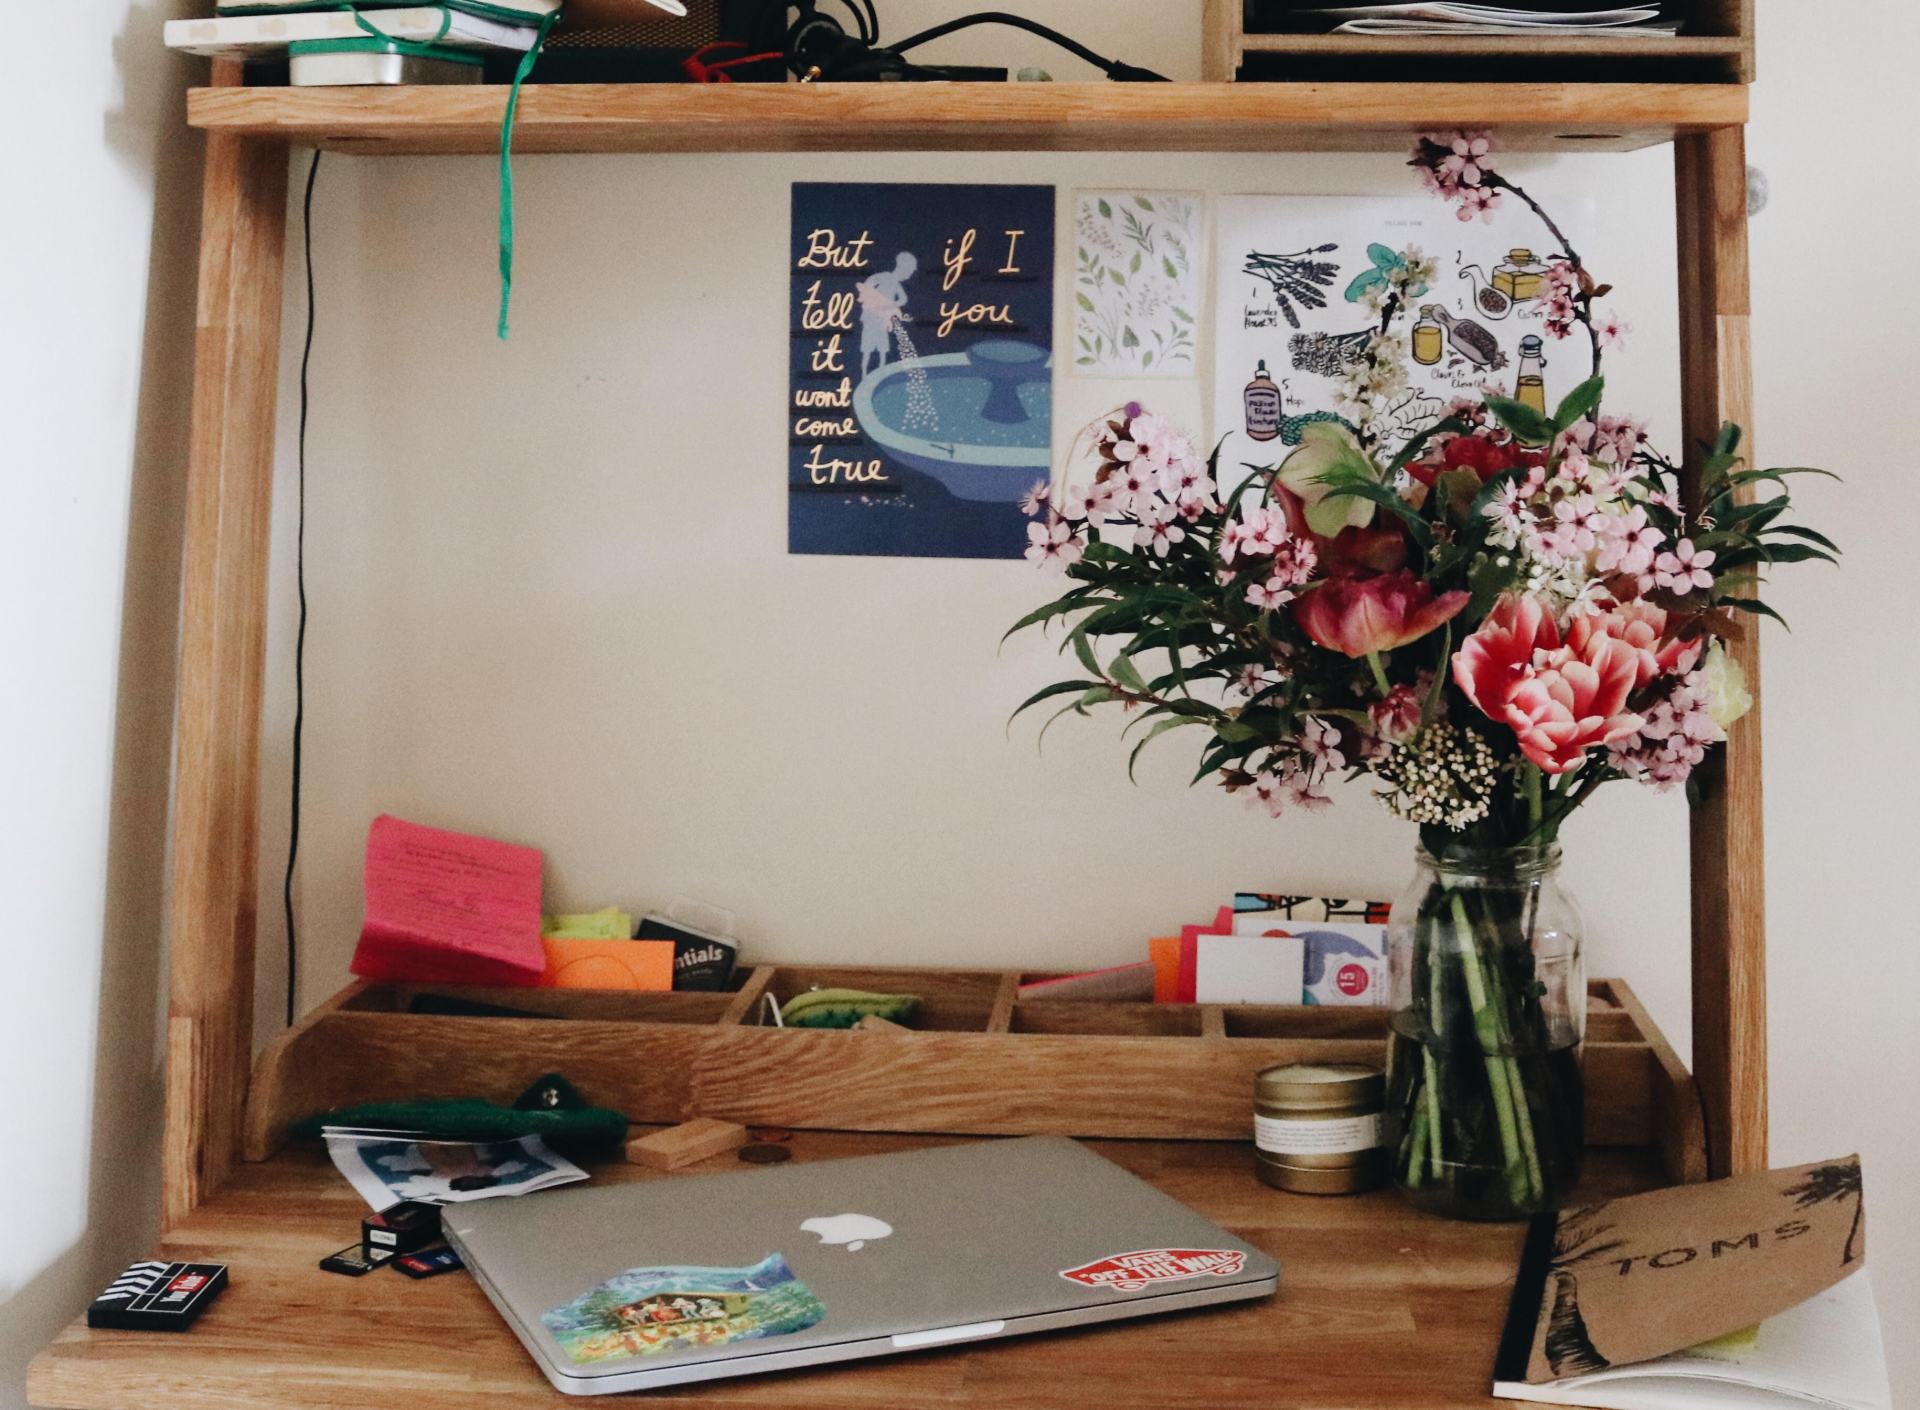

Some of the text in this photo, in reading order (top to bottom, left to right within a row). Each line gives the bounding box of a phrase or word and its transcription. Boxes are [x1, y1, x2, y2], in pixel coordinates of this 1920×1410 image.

[798, 228, 1025, 291] But if I
[801, 280, 1014, 338] tell you
[811, 334, 845, 372] it
[794, 377, 851, 409] wont
[794, 416, 859, 437] come
[803, 444, 889, 485] true
[1339, 971, 1356, 988] 15
[1108, 1251, 1178, 1270] VANS
[1610, 1220, 1812, 1277] TOMS
[1129, 1261, 1185, 1279] THE
